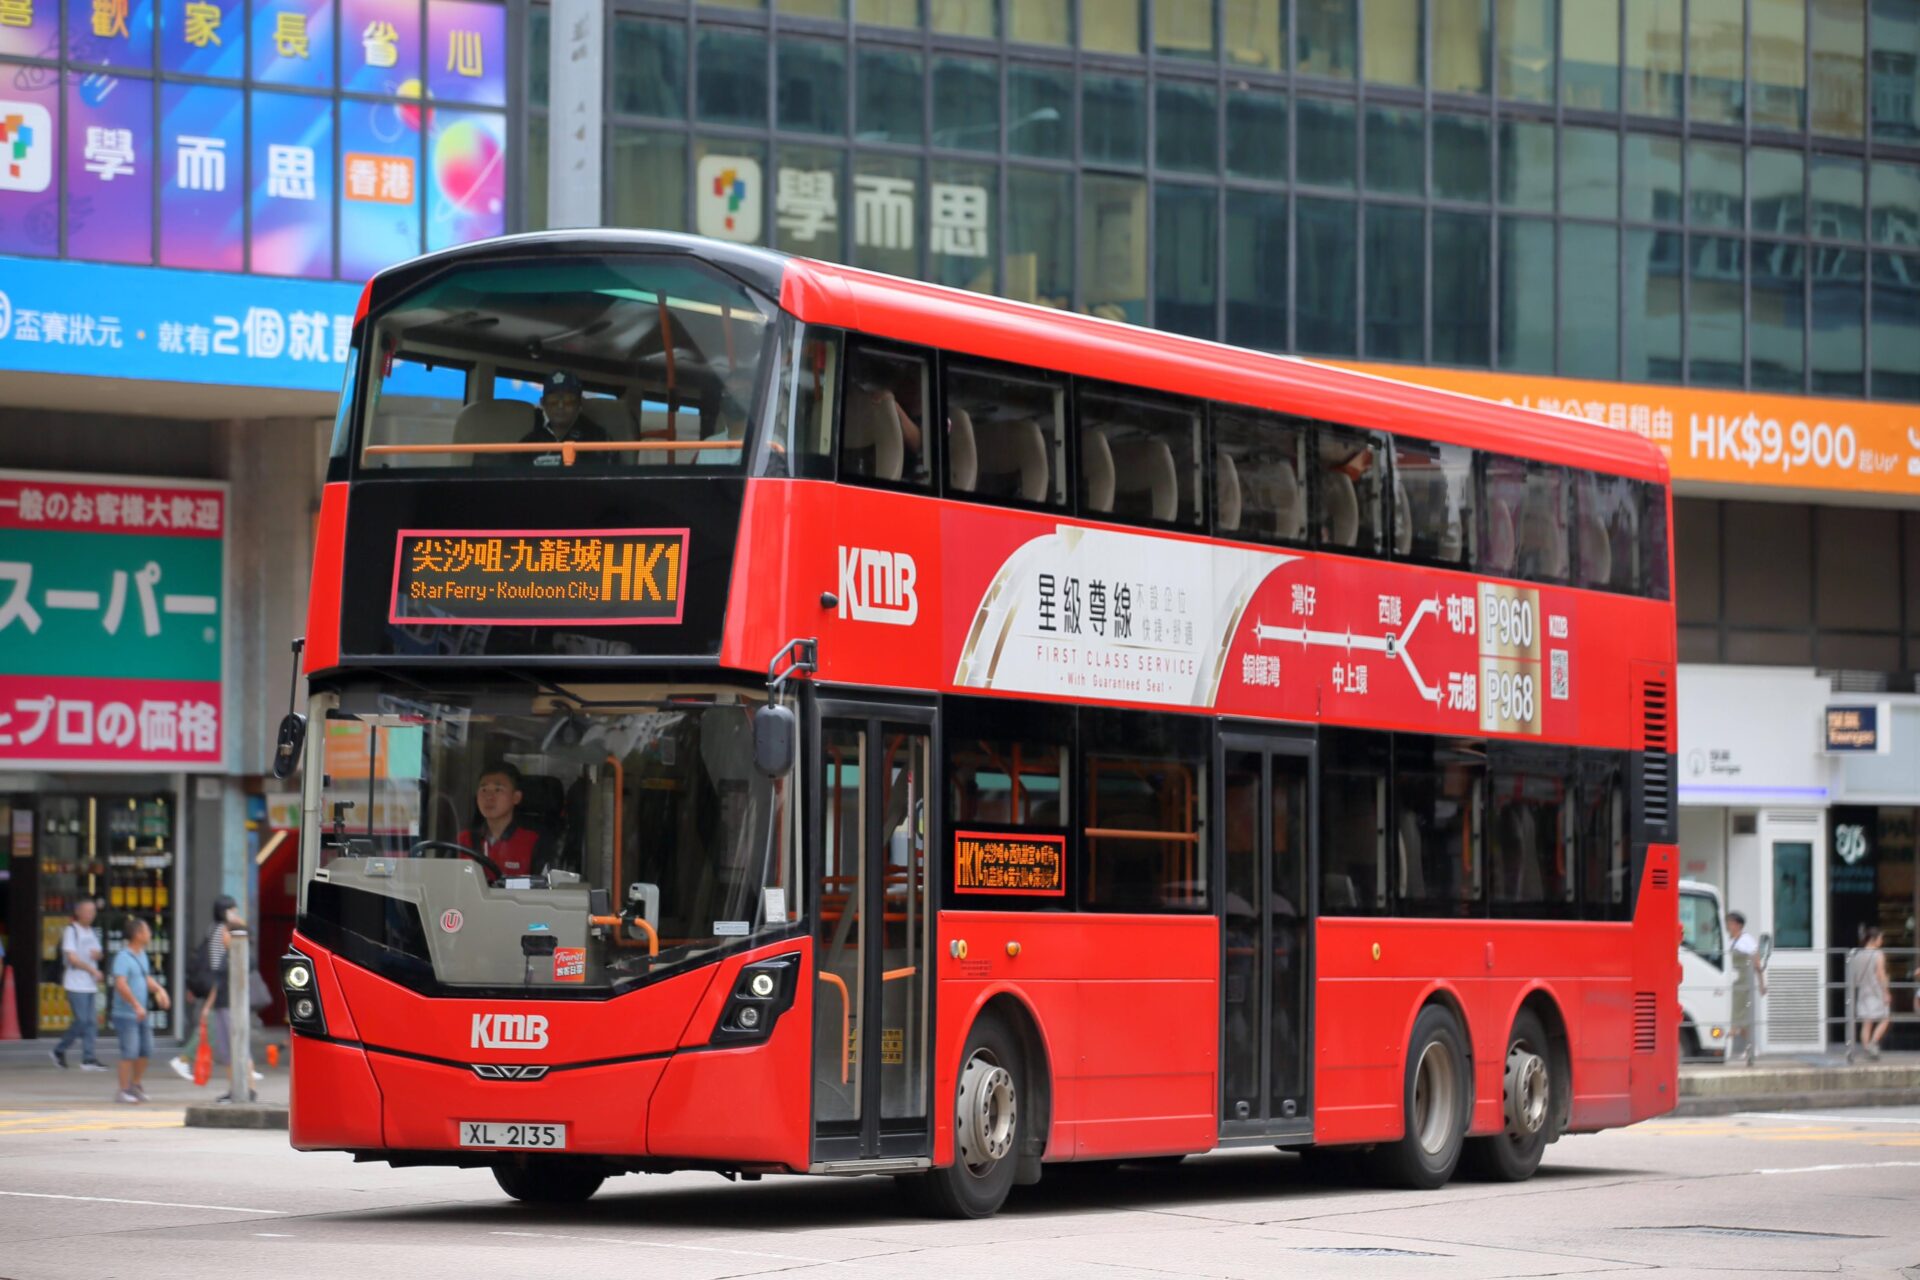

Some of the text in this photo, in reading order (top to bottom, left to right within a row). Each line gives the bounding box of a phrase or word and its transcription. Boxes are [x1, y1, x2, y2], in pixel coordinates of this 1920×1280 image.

[84, 126, 411, 200] 學而思 香港
[777, 166, 988, 258] 學而思
[0, 290, 123, 349] 盃賽狀元
[1689, 411, 1857, 472] HK$9,900
[410, 581, 600, 601] Star Ferry Kowloon City
[601, 543, 680, 601] HK1
[837, 545, 917, 626] KMB
[1038, 573, 1133, 639] 星級尊線
[1291, 583, 1316, 616] 灣仔
[1446, 593, 1533, 648] 屯門 P960
[1036, 645, 1194, 677] FIRST CLASS SERVICE
[1067, 672, 1086, 687] With
[1092, 673, 1141, 692] Guaranteed
[1331, 661, 1368, 695] 中上環
[1447, 668, 1534, 722] 元朗 P968
[470, 1013, 549, 1050] KMB
[469, 1124, 556, 1147] XL 2135
